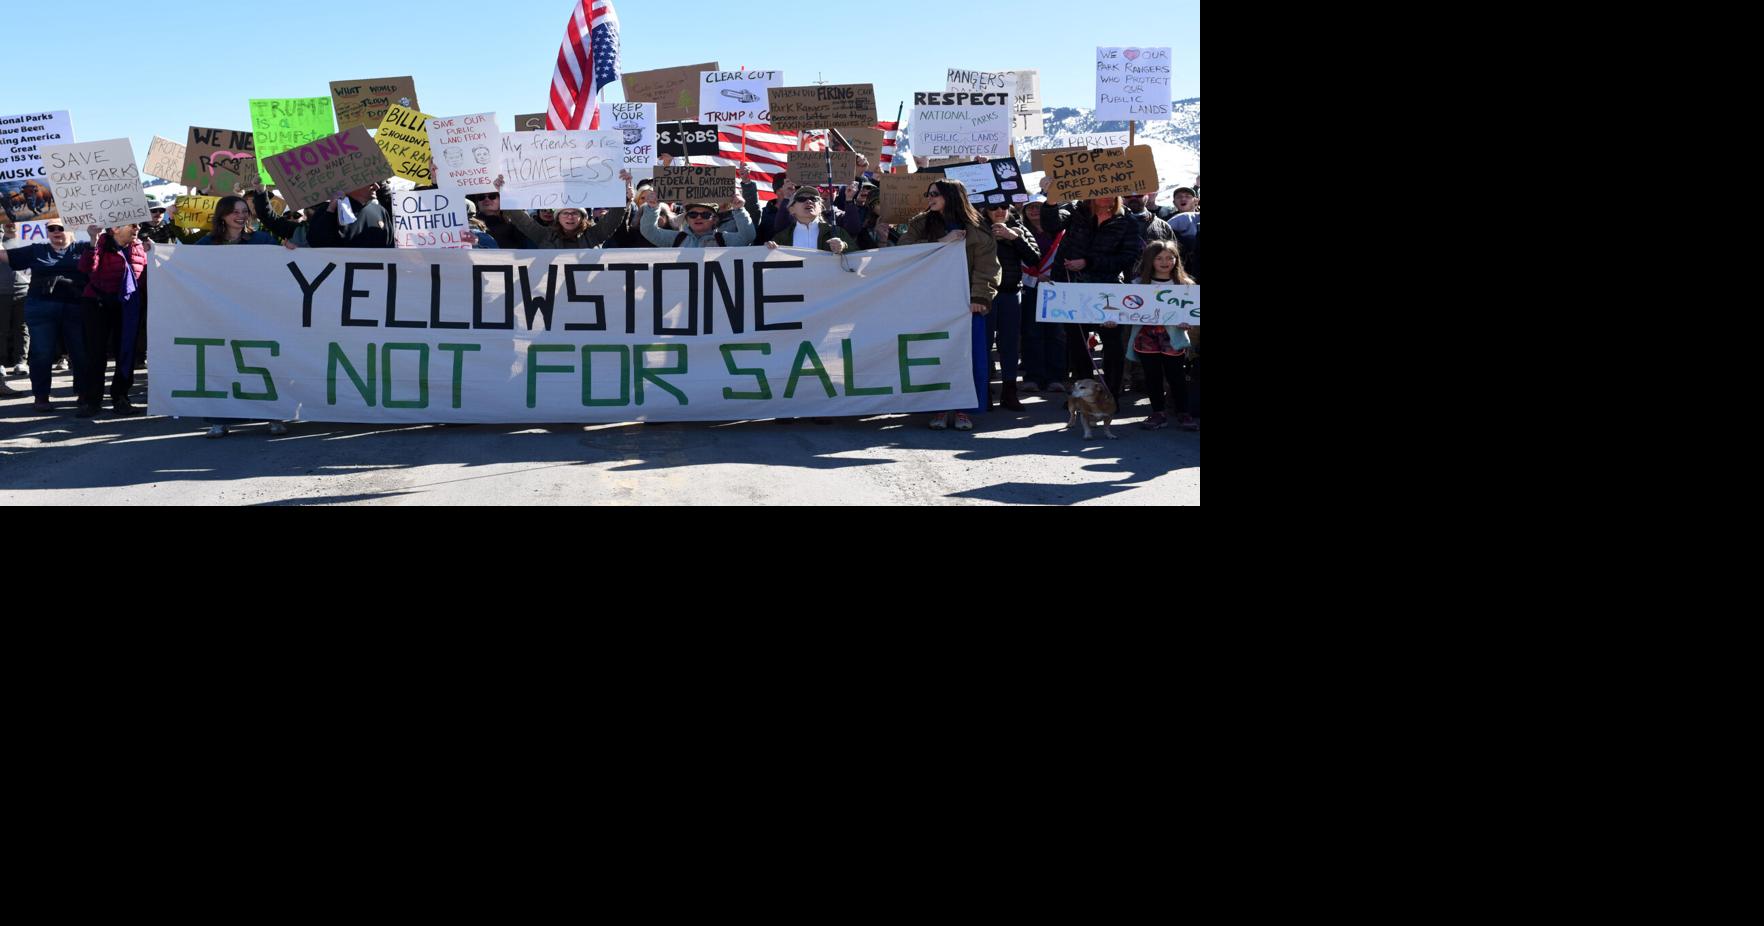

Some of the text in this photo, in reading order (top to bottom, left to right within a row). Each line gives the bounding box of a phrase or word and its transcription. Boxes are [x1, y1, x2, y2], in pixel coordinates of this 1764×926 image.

[1101, 50, 1168, 59] WE OUR
[1097, 61, 1170, 74] PARK RANGERS
[706, 70, 776, 83] CLEAR CUT
[947, 68, 1005, 88] RANGERS
[1100, 74, 1170, 86] WHO PROTECT
[817, 86, 854, 101] FIRING
[1123, 85, 1144, 94] OUR
[914, 92, 1008, 106] RESPECT
[1101, 93, 1144, 104] PUBLIC
[253, 97, 329, 118] TRUMP
[612, 102, 643, 112] KEEP
[1130, 104, 1168, 114] LANDS
[26, 114, 54, 122] Parks
[386, 107, 427, 133] BILLI
[432, 114, 486, 130] SAVE OUR
[612, 112, 644, 121] YOUR
[704, 111, 746, 122] TRUMP
[920, 110, 999, 127] NATIONAL PARKS
[20, 132, 61, 143] America
[446, 126, 475, 135] PUBLIC
[464, 132, 487, 142] FROM
[924, 133, 999, 142] PUBLIC LANDS
[193, 128, 256, 150] WE NE
[1068, 134, 1128, 148] PARKIES
[10, 145, 36, 154] Great
[501, 135, 522, 159] My
[531, 134, 576, 150] friends
[633, 145, 652, 154] OFF
[11, 154, 26, 162] 153
[52, 150, 110, 168] SAVE
[279, 132, 359, 176] HONK
[624, 156, 650, 164] OKEY
[1053, 151, 1101, 168] STOP
[0, 167, 34, 180] MUSK
[51, 163, 140, 183] OUR PARKS
[449, 167, 488, 178] INVASIVE
[506, 156, 614, 182] HOMELESS
[664, 166, 720, 176] SUPPORT
[1053, 160, 1134, 180] LAND GRABS
[456, 176, 492, 187] SPECIES
[654, 176, 736, 186] FEDERAL EMPLOYEES
[1056, 176, 1096, 190] GREED
[1099, 174, 1108, 183] IS
[1111, 171, 1135, 182] NOT
[56, 186, 86, 198] OUR
[657, 186, 736, 200] NOT BILLIONAIRES
[1060, 190, 1082, 200] THE
[1088, 186, 1130, 197] ANSWER
[62, 197, 137, 212] SAVE OUR
[402, 194, 449, 214] OLD
[530, 192, 588, 208] now
[394, 212, 464, 230] FAITHFUL
[22, 223, 48, 240] PA
[286, 259, 804, 336] YELLOWSTONE
[171, 332, 950, 408] IS NOT FOR SALE
